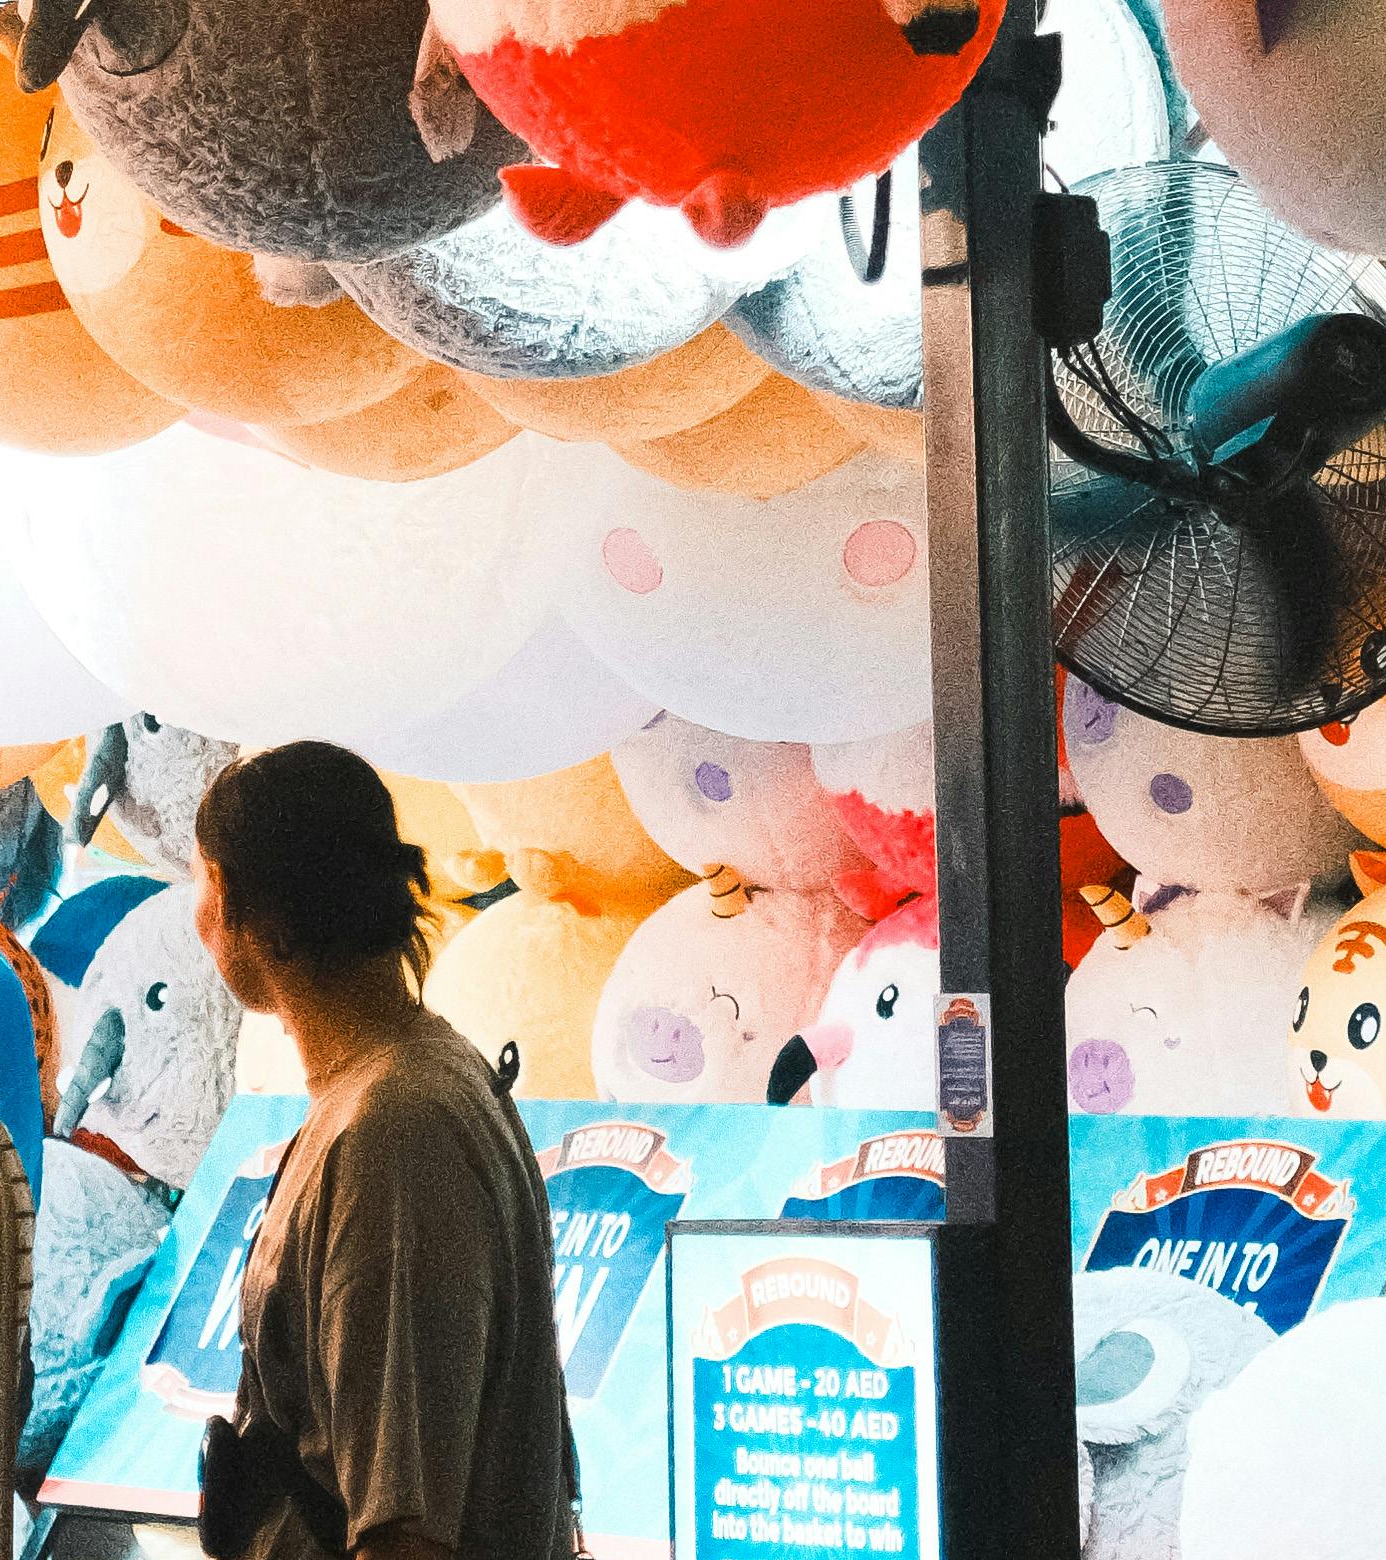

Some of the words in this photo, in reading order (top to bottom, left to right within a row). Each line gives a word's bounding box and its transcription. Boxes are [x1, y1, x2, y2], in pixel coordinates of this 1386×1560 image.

[566, 1127, 655, 1164] REBOUND
[863, 1135, 945, 1174] REBOUN
[1194, 1146, 1301, 1187] REBOUND
[588, 1212, 631, 1259] TO
[1195, 1241, 1237, 1291] IN
[1231, 1242, 1279, 1292] TO
[750, 1271, 850, 1309] REBOUND
[722, 1364, 732, 1393] 1
[735, 1364, 796, 1397] GAME
[813, 1366, 841, 1397] 20
[844, 1370, 890, 1399] AED
[713, 1402, 725, 1431] 3
[729, 1401, 803, 1436] GAMES
[818, 1408, 847, 1438] 40
[850, 1409, 899, 1441] AED
[736, 1446, 801, 1477] Bounce
[803, 1454, 838, 1480] one
[840, 1448, 875, 1483] ball
[714, 1477, 781, 1516] directly
[783, 1480, 810, 1511] off
[813, 1482, 843, 1514] the
[846, 1486, 899, 1518] board
[750, 1512, 780, 1543] the
[782, 1513, 843, 1548] basket
[846, 1520, 867, 1550] to
[869, 1521, 903, 1552] win
